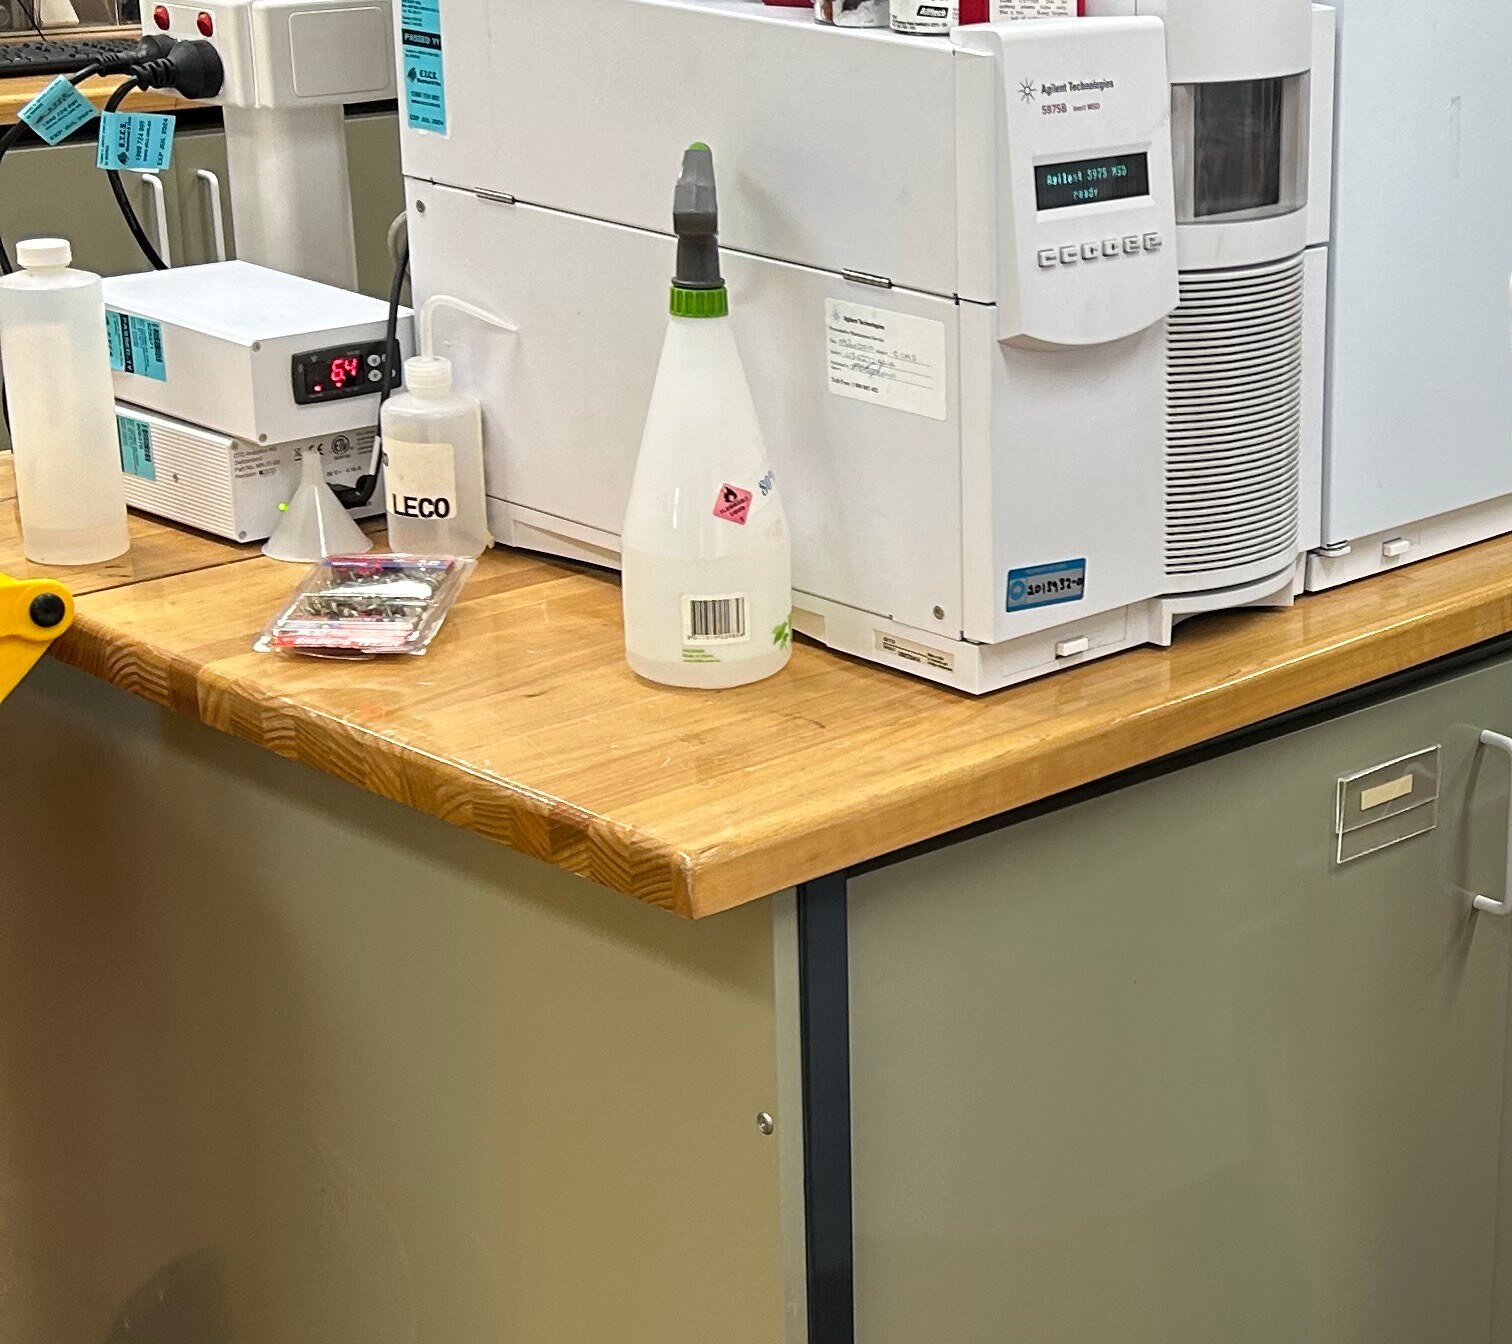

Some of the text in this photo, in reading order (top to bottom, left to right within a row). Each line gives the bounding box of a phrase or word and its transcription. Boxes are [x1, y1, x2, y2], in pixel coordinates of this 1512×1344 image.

[1041, 78, 1114, 96] Agilent Technologies
[1042, 103, 1067, 115] 5975B
[1046, 164, 1127, 186] Agilent 5975 MSD
[392, 493, 450, 518] LECO
